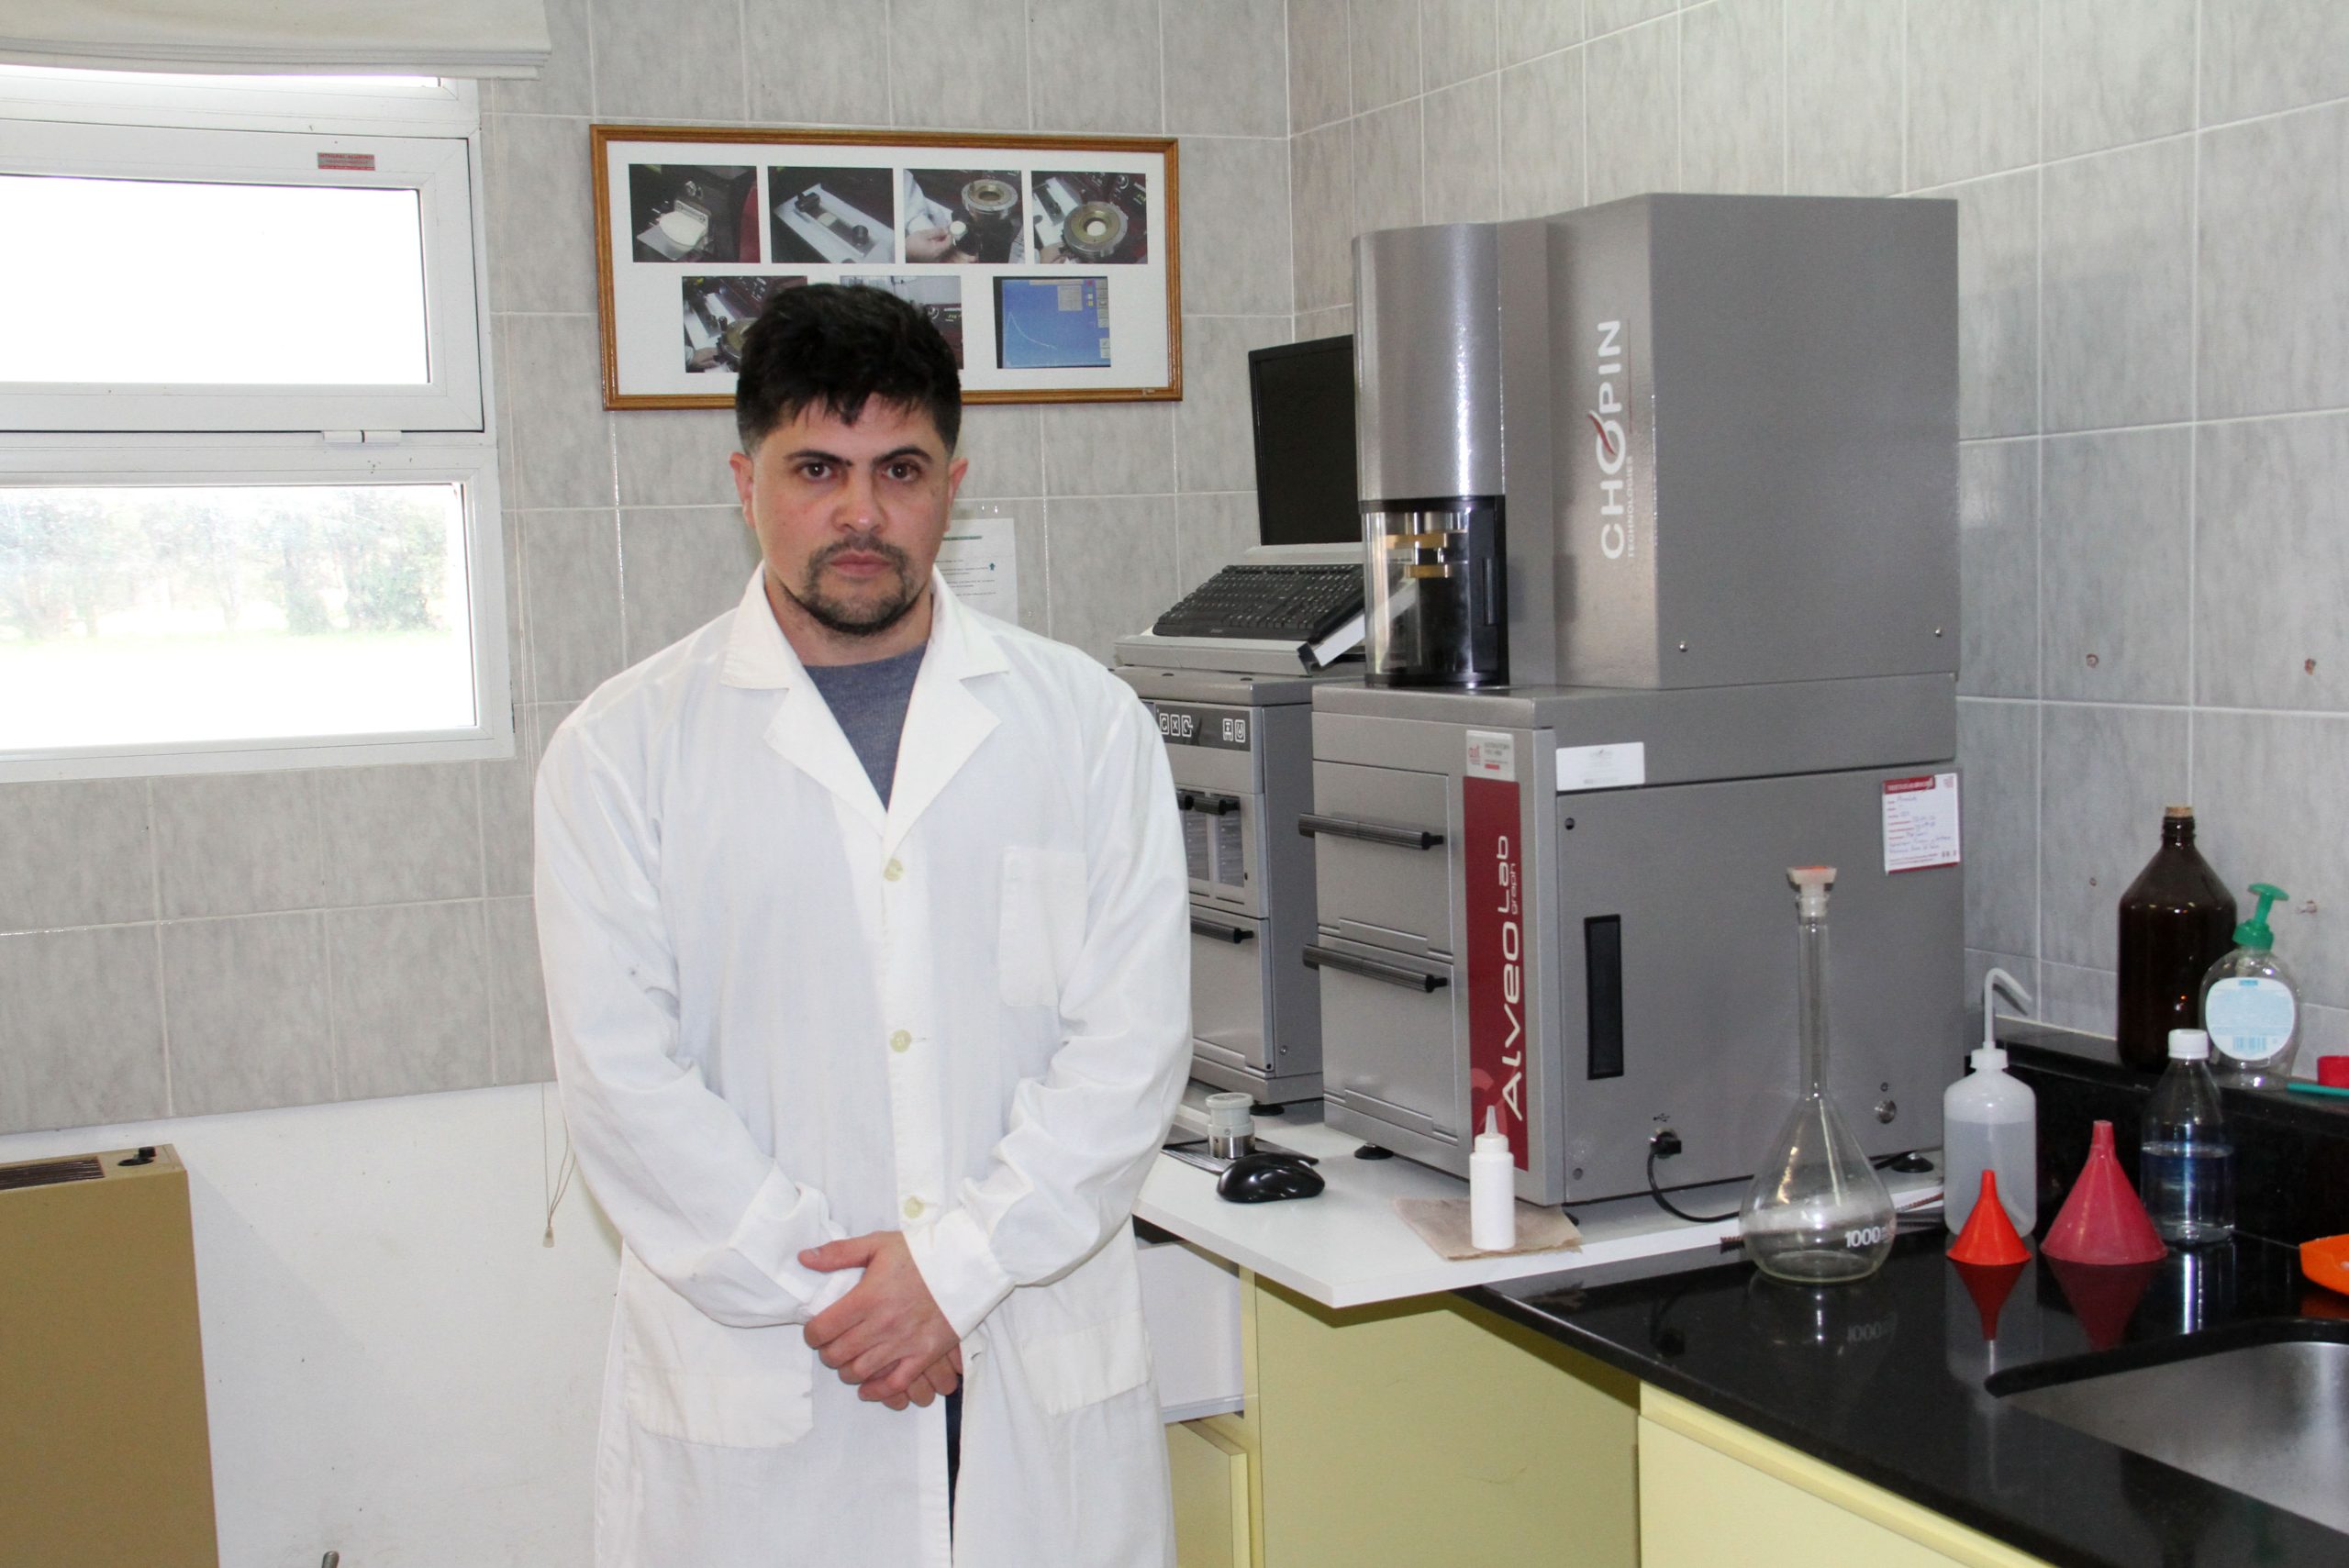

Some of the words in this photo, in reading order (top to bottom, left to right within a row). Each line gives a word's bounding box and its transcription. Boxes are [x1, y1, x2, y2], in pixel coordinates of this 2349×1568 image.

[1588, 320, 1626, 560] CHOPIN
[1625, 455, 1634, 558] TECHNOLOGIES
[1497, 835, 1510, 913] Lab
[1509, 862, 1519, 915] graph
[1844, 1226, 1880, 1248] 1000
